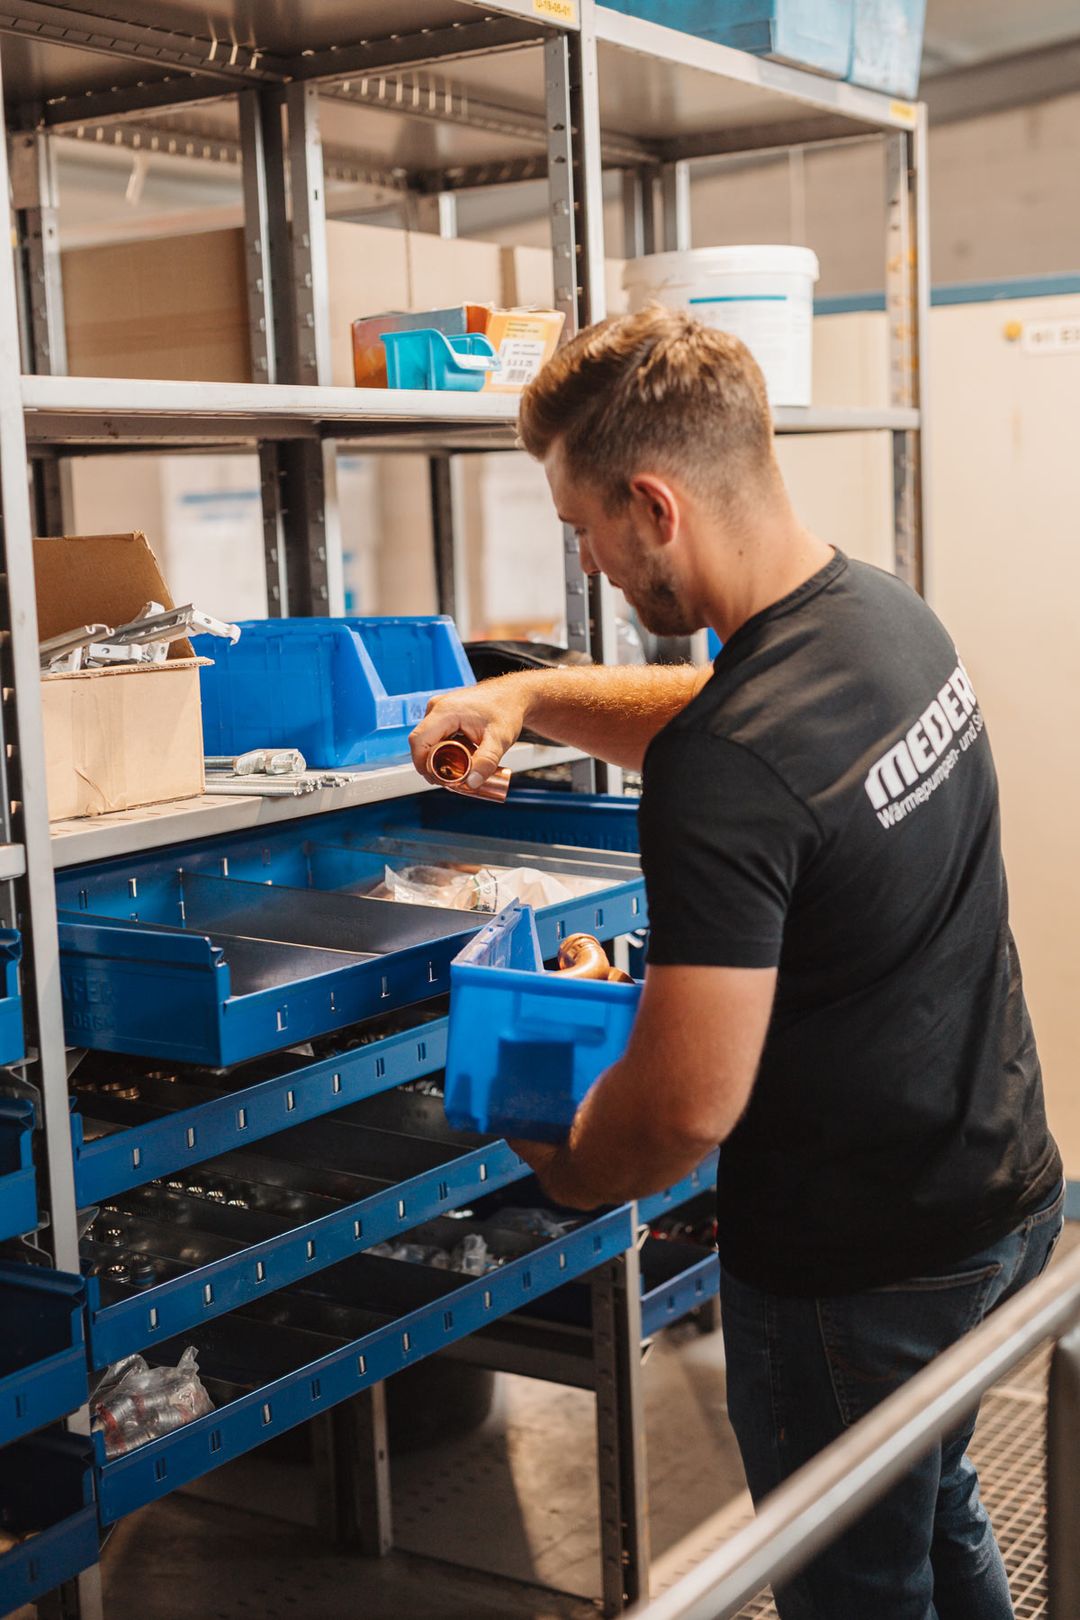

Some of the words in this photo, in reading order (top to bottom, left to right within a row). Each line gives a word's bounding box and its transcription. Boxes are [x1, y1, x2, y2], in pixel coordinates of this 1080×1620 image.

[864, 649, 977, 810] MEDER
[876, 748, 961, 829] Wärmepumpen-
[959, 720, 978, 752] und
